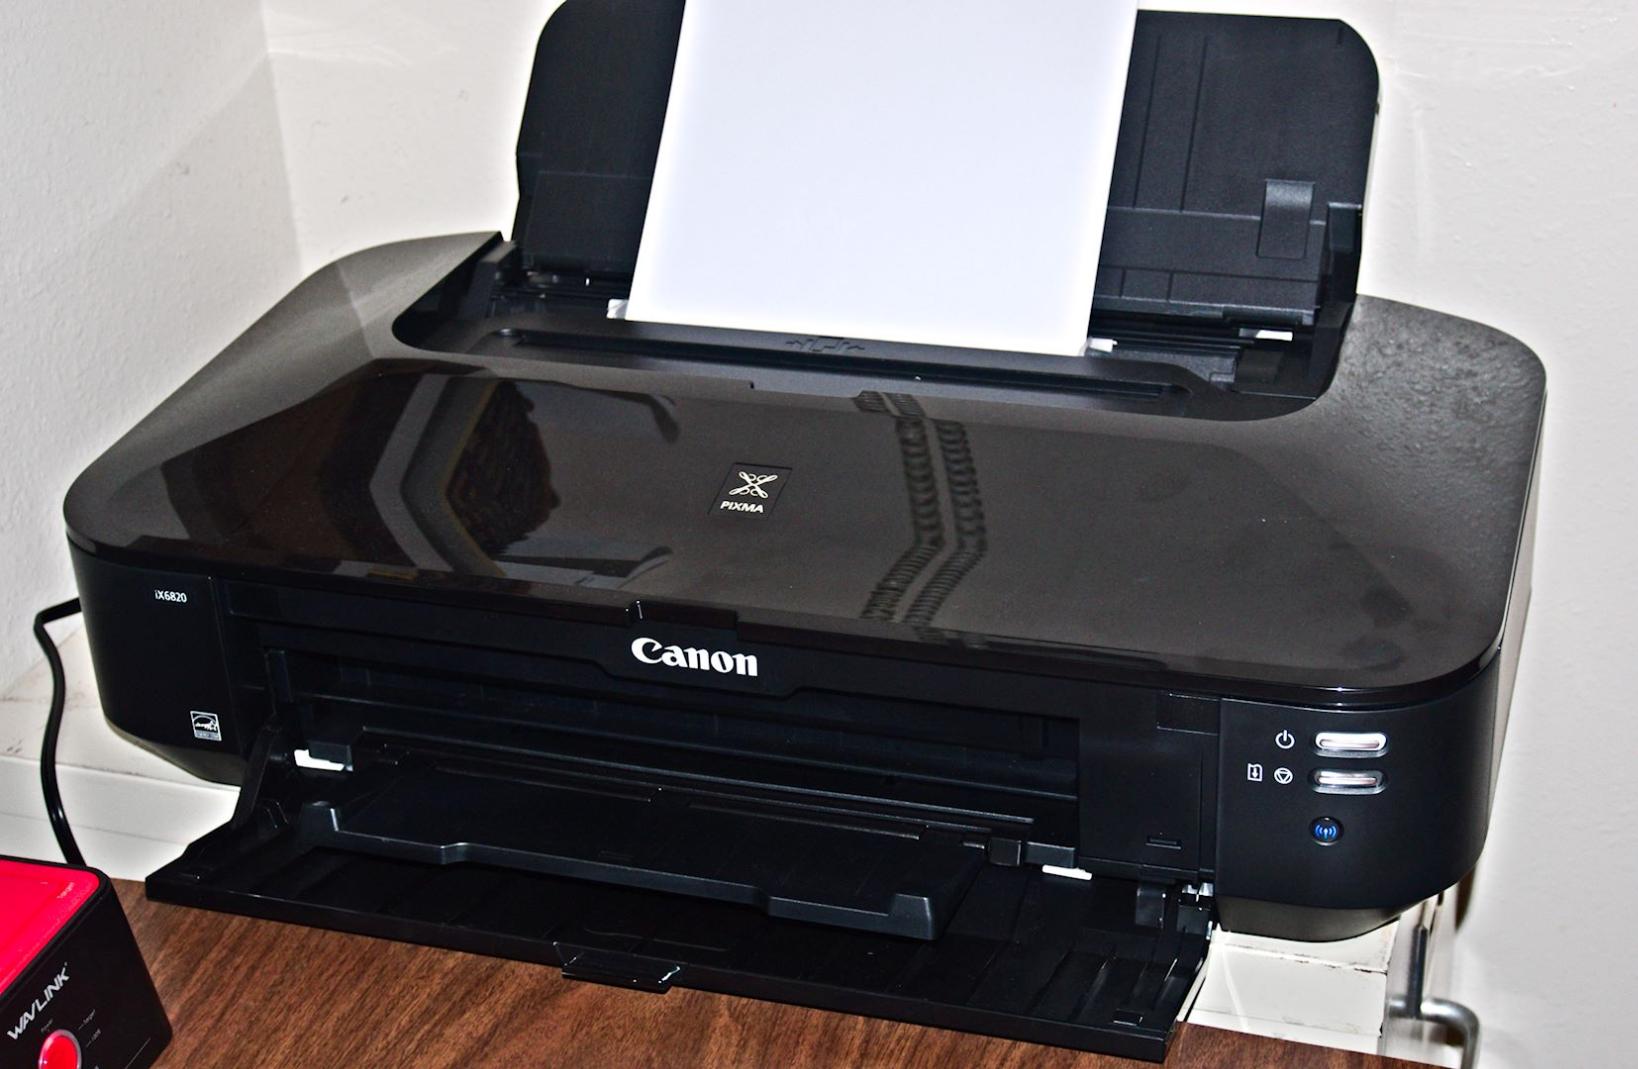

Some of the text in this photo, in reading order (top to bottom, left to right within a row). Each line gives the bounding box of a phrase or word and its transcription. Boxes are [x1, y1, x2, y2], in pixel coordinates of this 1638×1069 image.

[720, 501, 764, 513] PIXMA
[154, 589, 188, 603] iX6820
[631, 637, 759, 677] Canon
[7, 966, 70, 1040] WAVLINK
